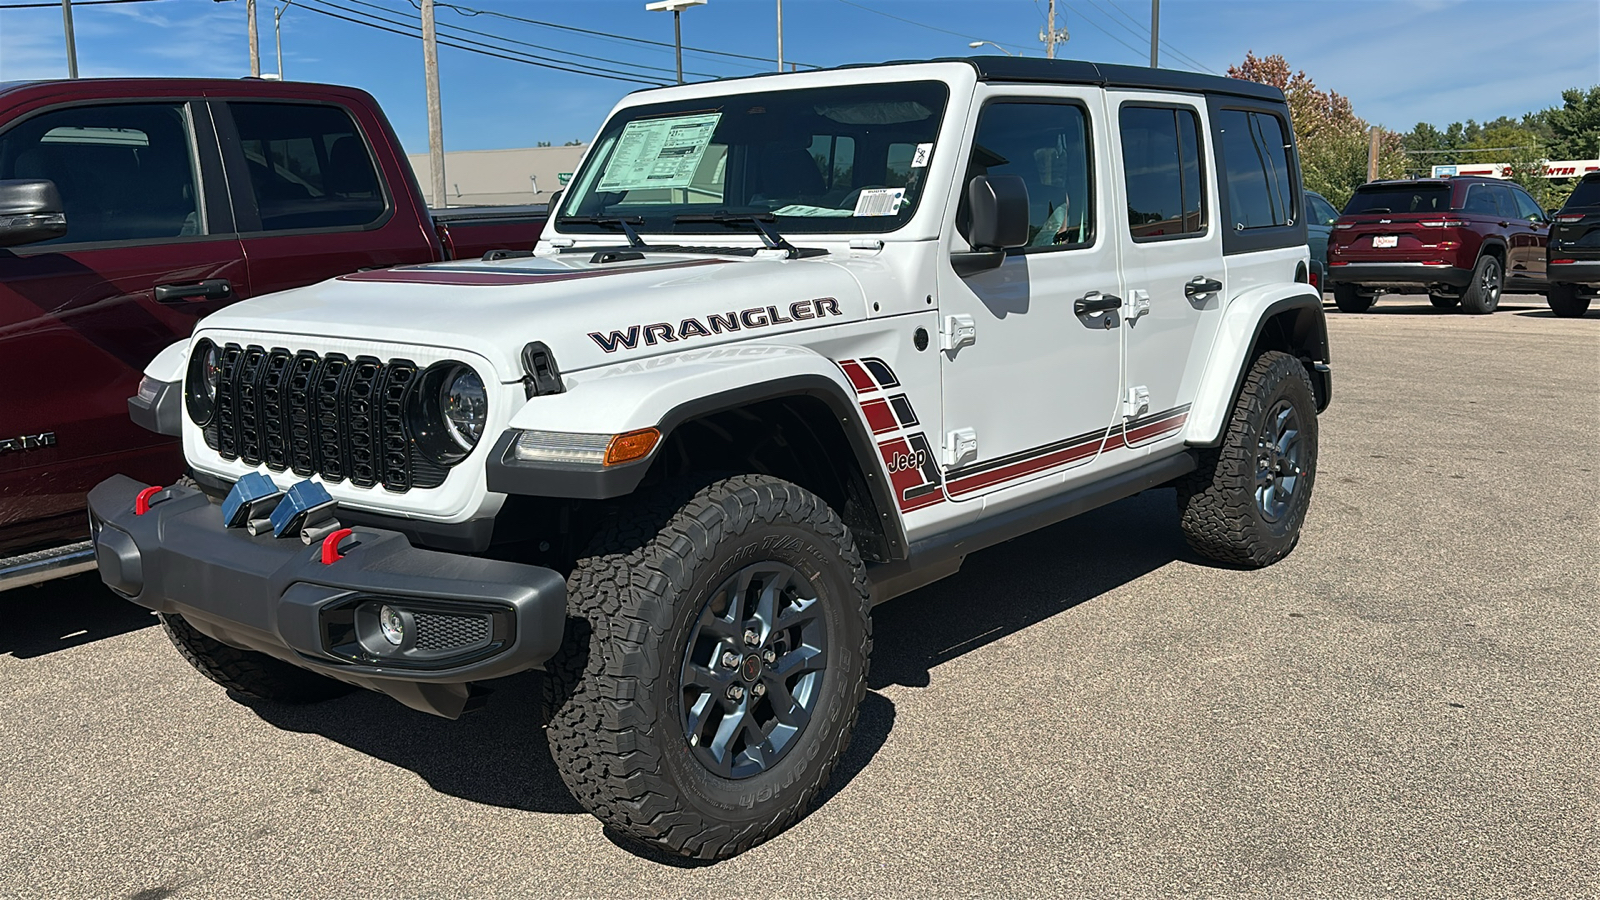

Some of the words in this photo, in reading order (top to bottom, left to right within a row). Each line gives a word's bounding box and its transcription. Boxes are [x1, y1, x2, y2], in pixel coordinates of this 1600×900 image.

[586, 296, 843, 354] WRANGLER
[887, 449, 927, 474] Jeep
[761, 534, 806, 554] T/A
[738, 646, 852, 811] BFGoodrich
